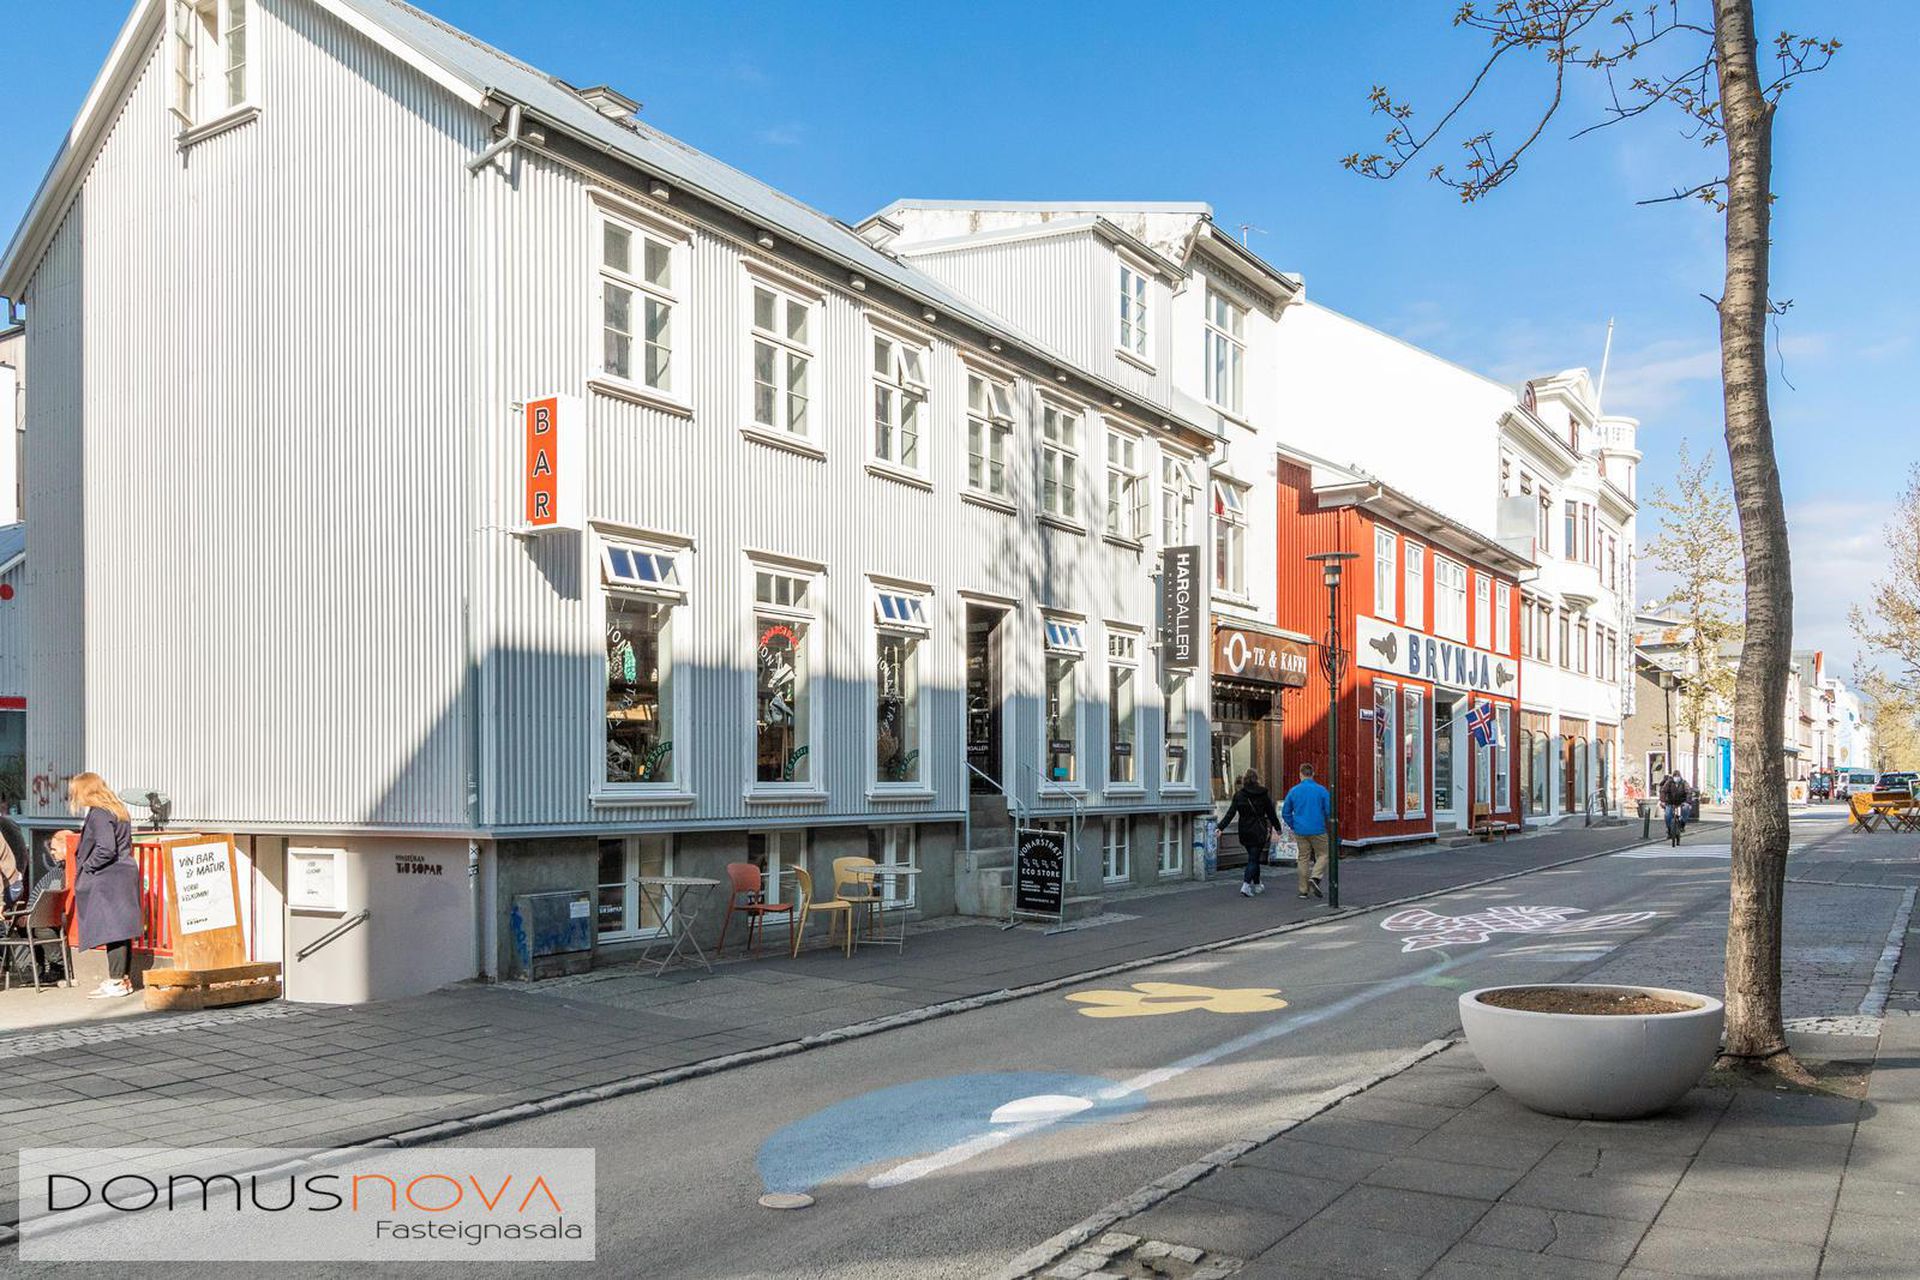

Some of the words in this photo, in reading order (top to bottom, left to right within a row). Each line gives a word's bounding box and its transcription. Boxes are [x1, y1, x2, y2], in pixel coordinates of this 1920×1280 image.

[533, 407, 551, 518] BAR
[1253, 647, 1266, 667] TE
[1268, 649, 1277, 668] &
[1280, 652, 1307, 673] KAFFI
[1408, 633, 1490, 690] BRYNJA
[196, 852, 214, 864] BAR
[196, 861, 225, 875] MATUR
[412, 863, 442, 875] SOPAR
[1021, 868, 1035, 876] ECO
[1037, 869, 1060, 878] STORE
